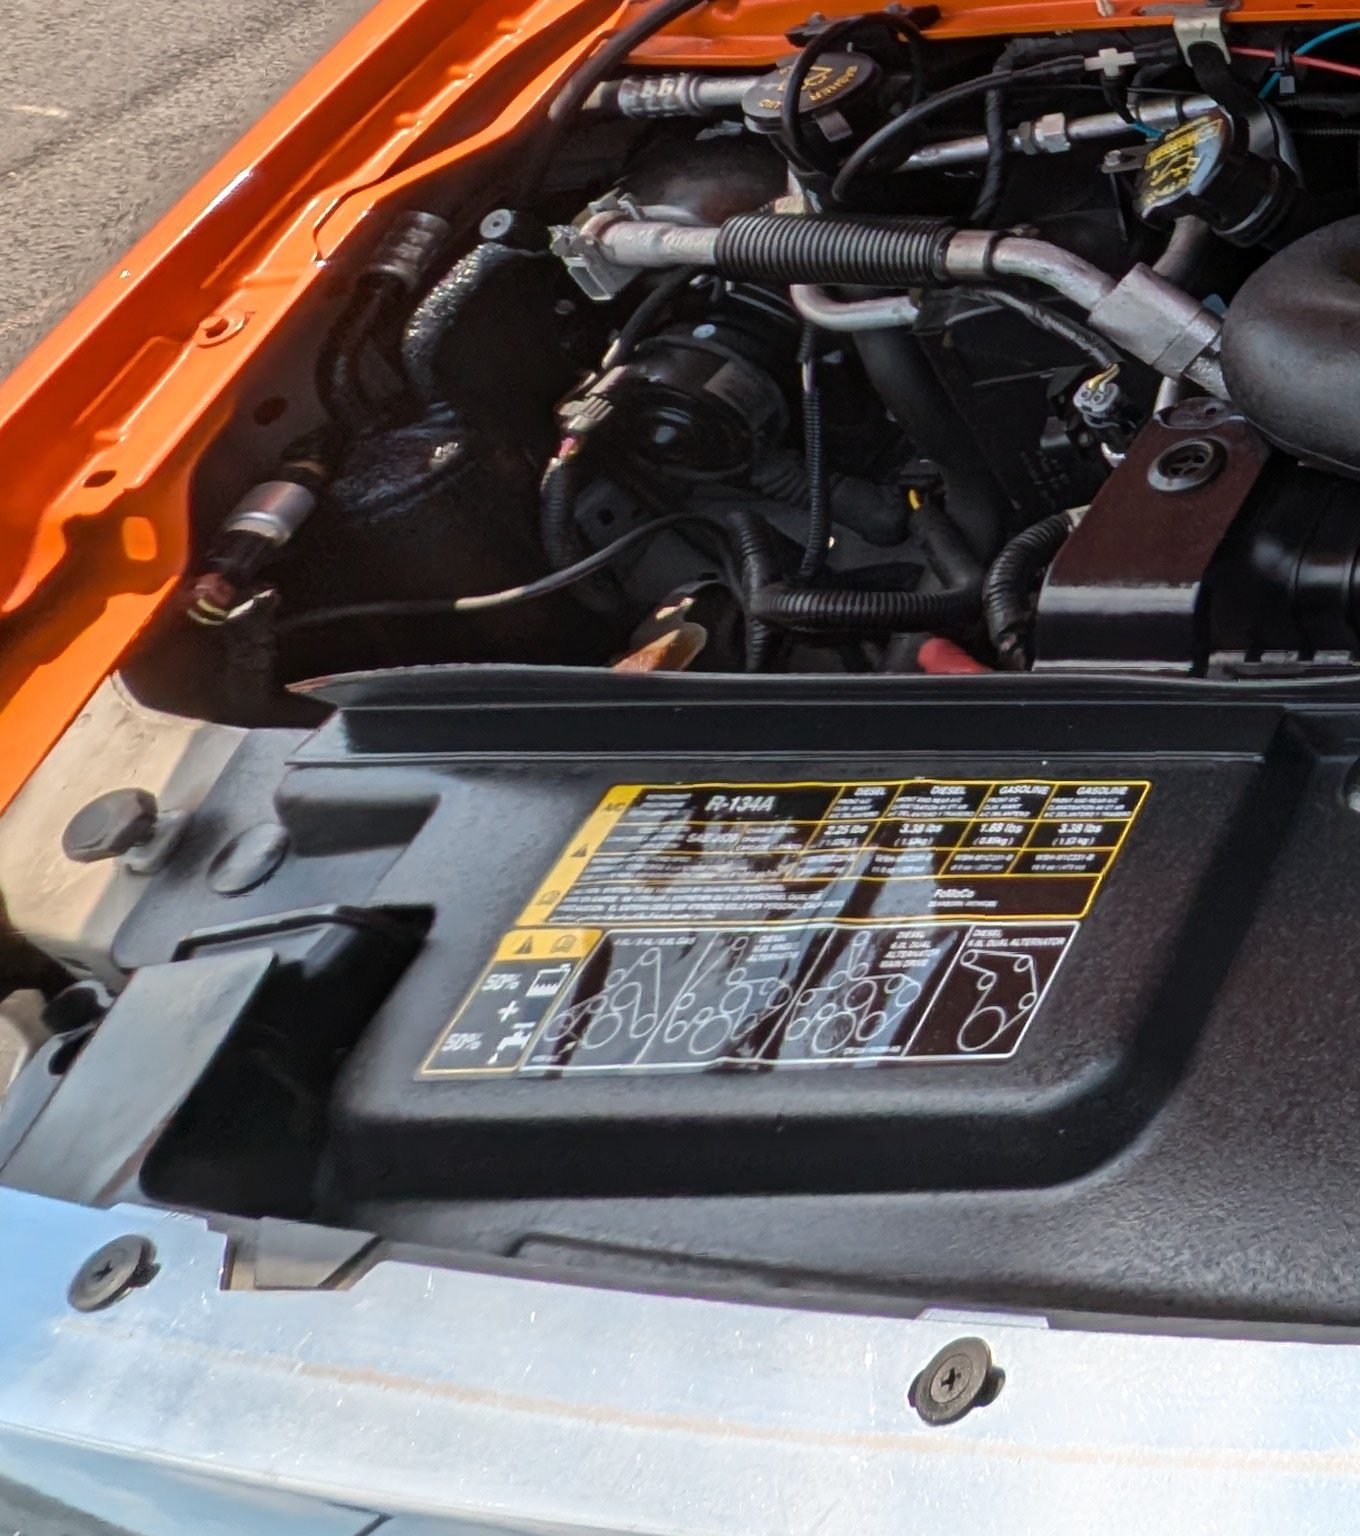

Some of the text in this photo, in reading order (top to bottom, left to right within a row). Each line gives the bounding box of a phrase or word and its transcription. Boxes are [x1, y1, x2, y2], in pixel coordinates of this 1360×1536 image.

[928, 785, 969, 795] DIESEL
[996, 785, 1051, 795] GASOLINE
[1074, 786, 1129, 795] GASOLINE
[701, 794, 779, 811] R-134A
[894, 930, 927, 939] DIESEL
[970, 928, 1006, 938] DIESEL
[984, 936, 1067, 946] DUAL ALTERNATOR
[481, 973, 523, 991] 50%
[440, 1032, 484, 1052] 50%
